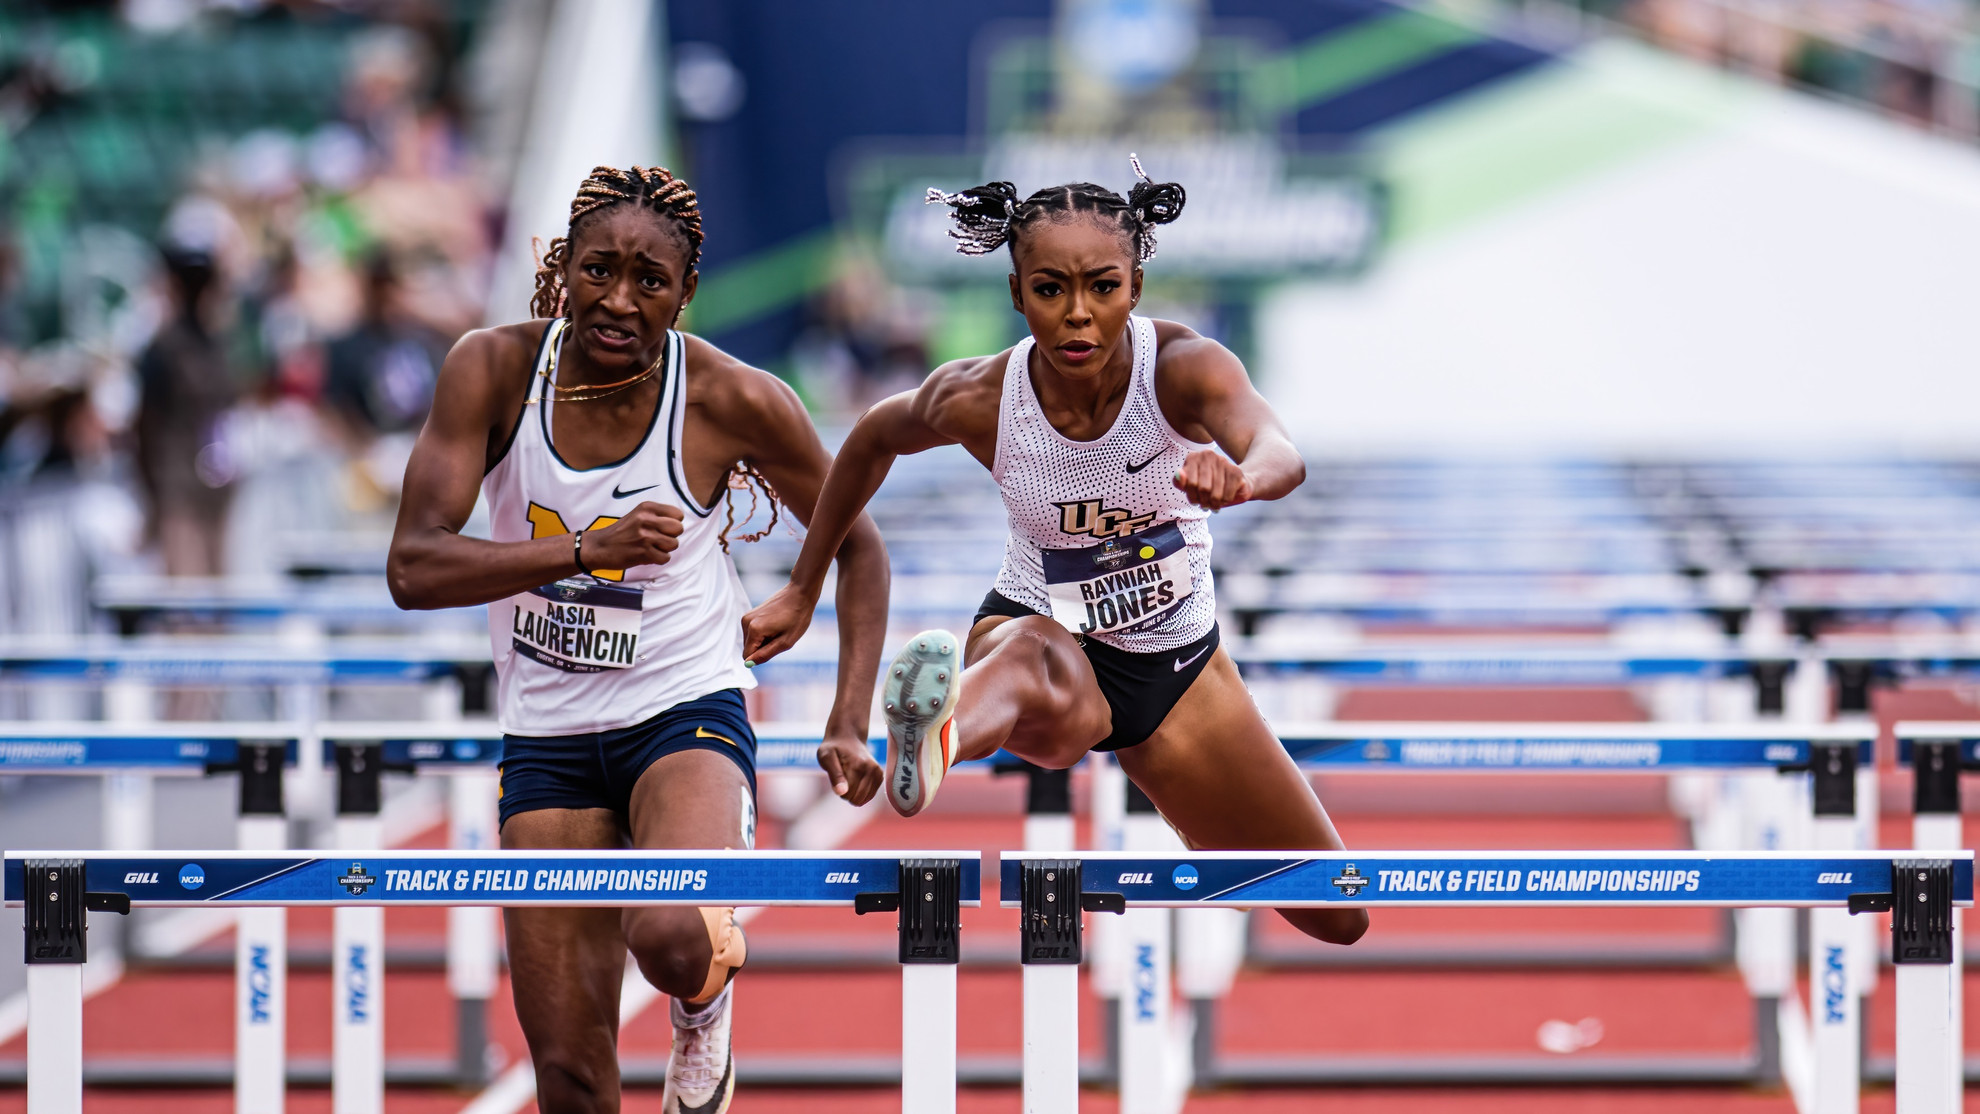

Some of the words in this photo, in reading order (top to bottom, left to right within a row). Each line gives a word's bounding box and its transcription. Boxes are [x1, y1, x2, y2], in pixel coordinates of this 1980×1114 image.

[1050, 498, 1158, 539] UCF
[1079, 563, 1163, 601] RAYNIAH
[546, 601, 596, 626] AASIA
[1079, 580, 1175, 634] JONES
[513, 605, 638, 665] LAURENCIN
[1142, 618, 1156, 630] JUNE
[124, 872, 159, 884] GILL
[181, 876, 205, 884] NCAA
[385, 869, 452, 891] TRACK
[453, 869, 470, 891] &
[472, 869, 529, 891] FIELD
[533, 869, 708, 891] CHAMPIONSHIPS
[825, 872, 860, 884] GILL
[1118, 872, 1153, 884] GILL
[1175, 876, 1198, 884] NCAA
[1378, 870, 1445, 892] TRACK
[1446, 870, 1462, 892] &
[1464, 870, 1522, 892] FIELD
[1525, 870, 1700, 892] CHAMPIONSHIPS
[1817, 872, 1852, 884] GILL
[249, 944, 271, 1024] NCAA
[346, 944, 369, 1024] NCAA
[1133, 943, 1157, 1023] NCAA
[1824, 945, 1846, 1023] NCAA
